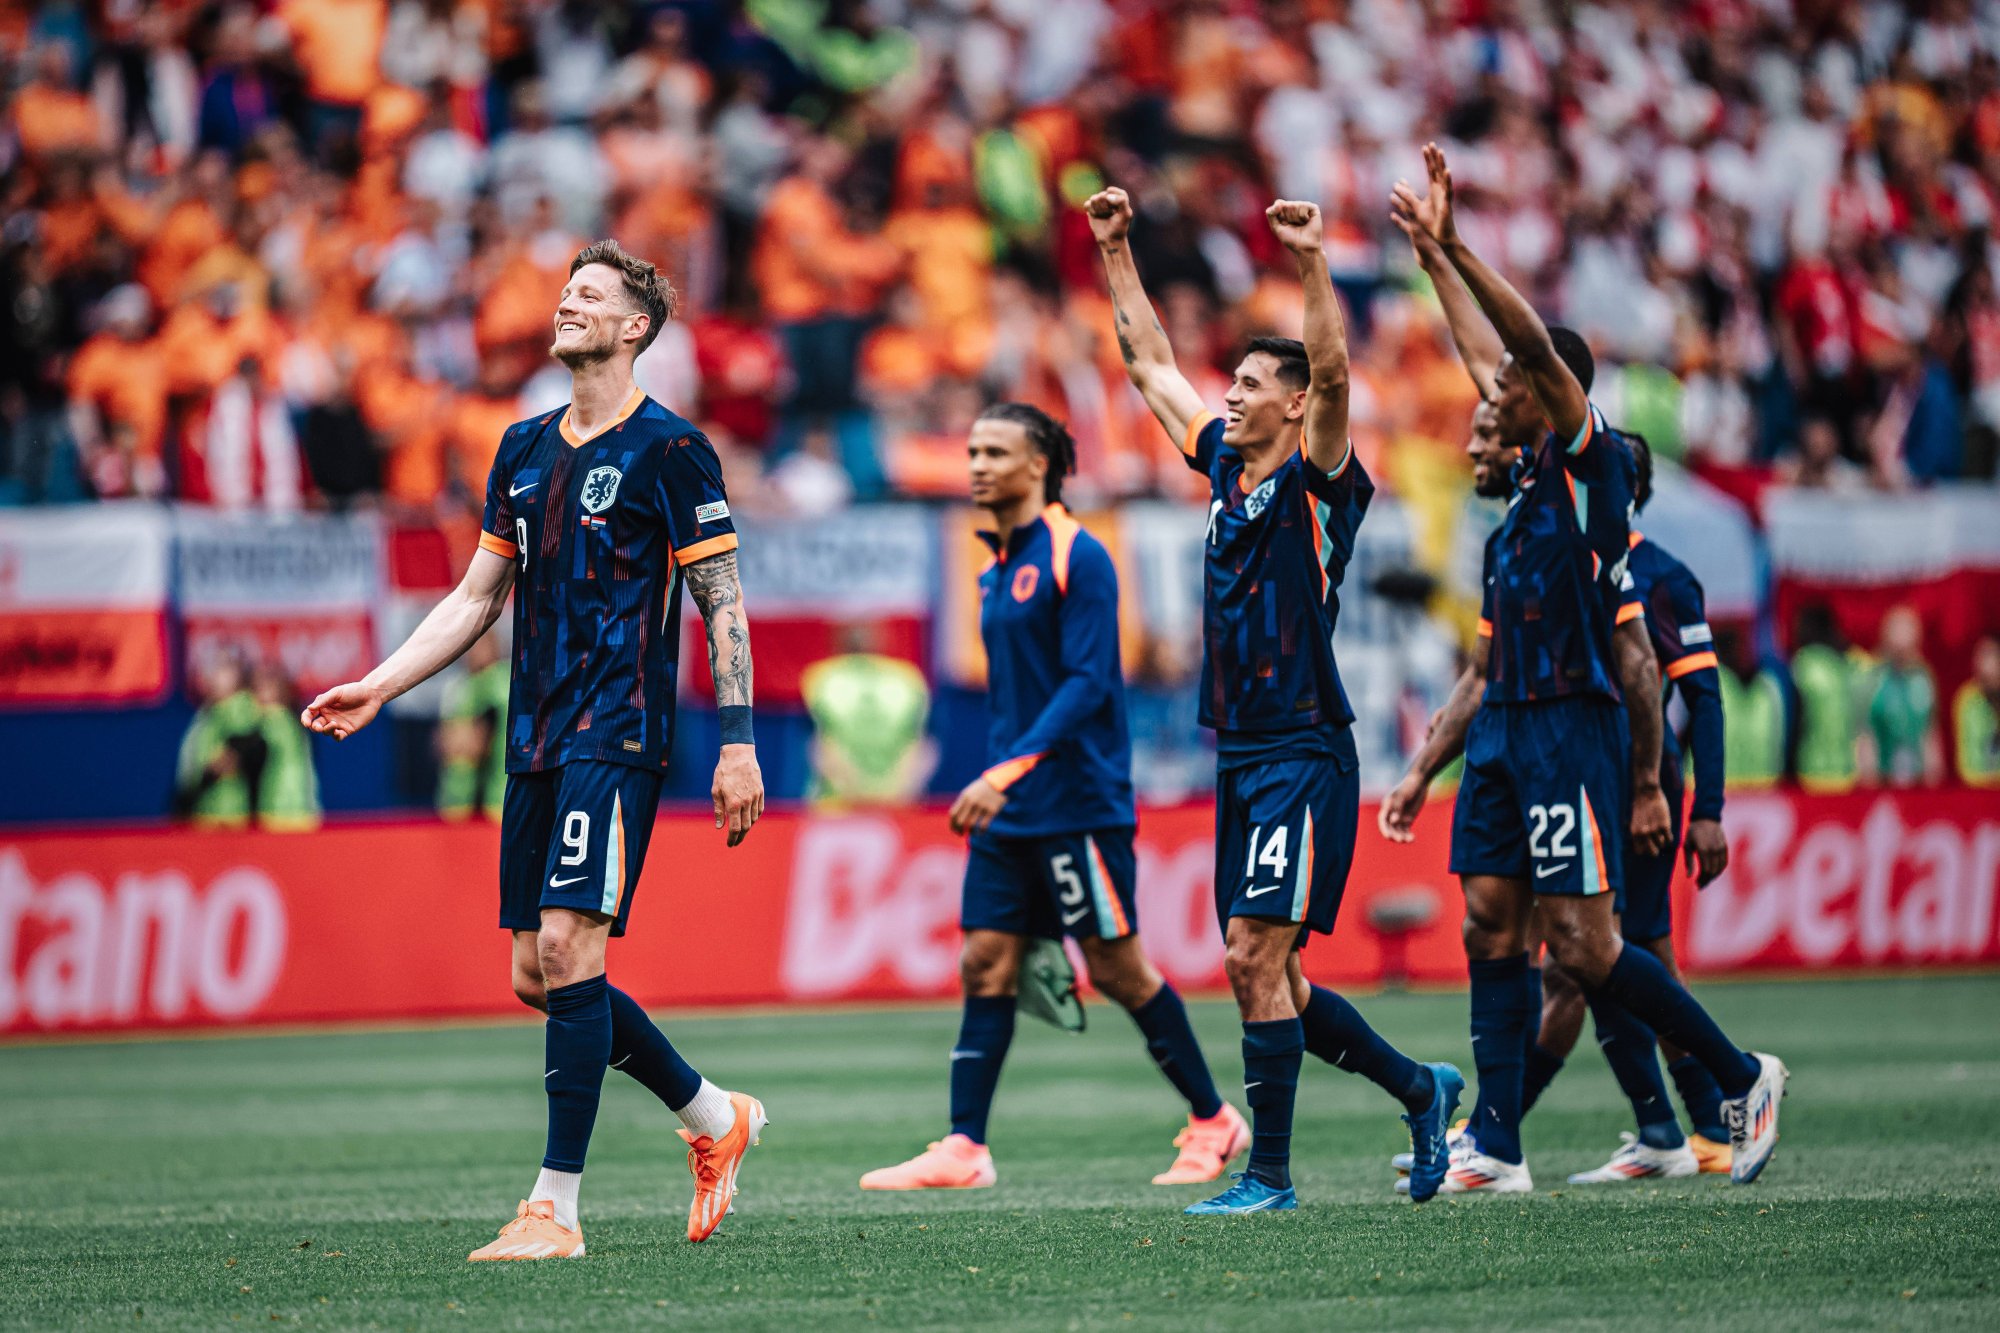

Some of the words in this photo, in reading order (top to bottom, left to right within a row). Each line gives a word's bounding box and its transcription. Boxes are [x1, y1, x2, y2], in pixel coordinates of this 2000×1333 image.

[516, 517, 528, 572] 9
[561, 811, 590, 866] 9
[1246, 825, 1288, 878] 14
[1529, 803, 1577, 857] 22
[1051, 853, 1085, 906] 5
